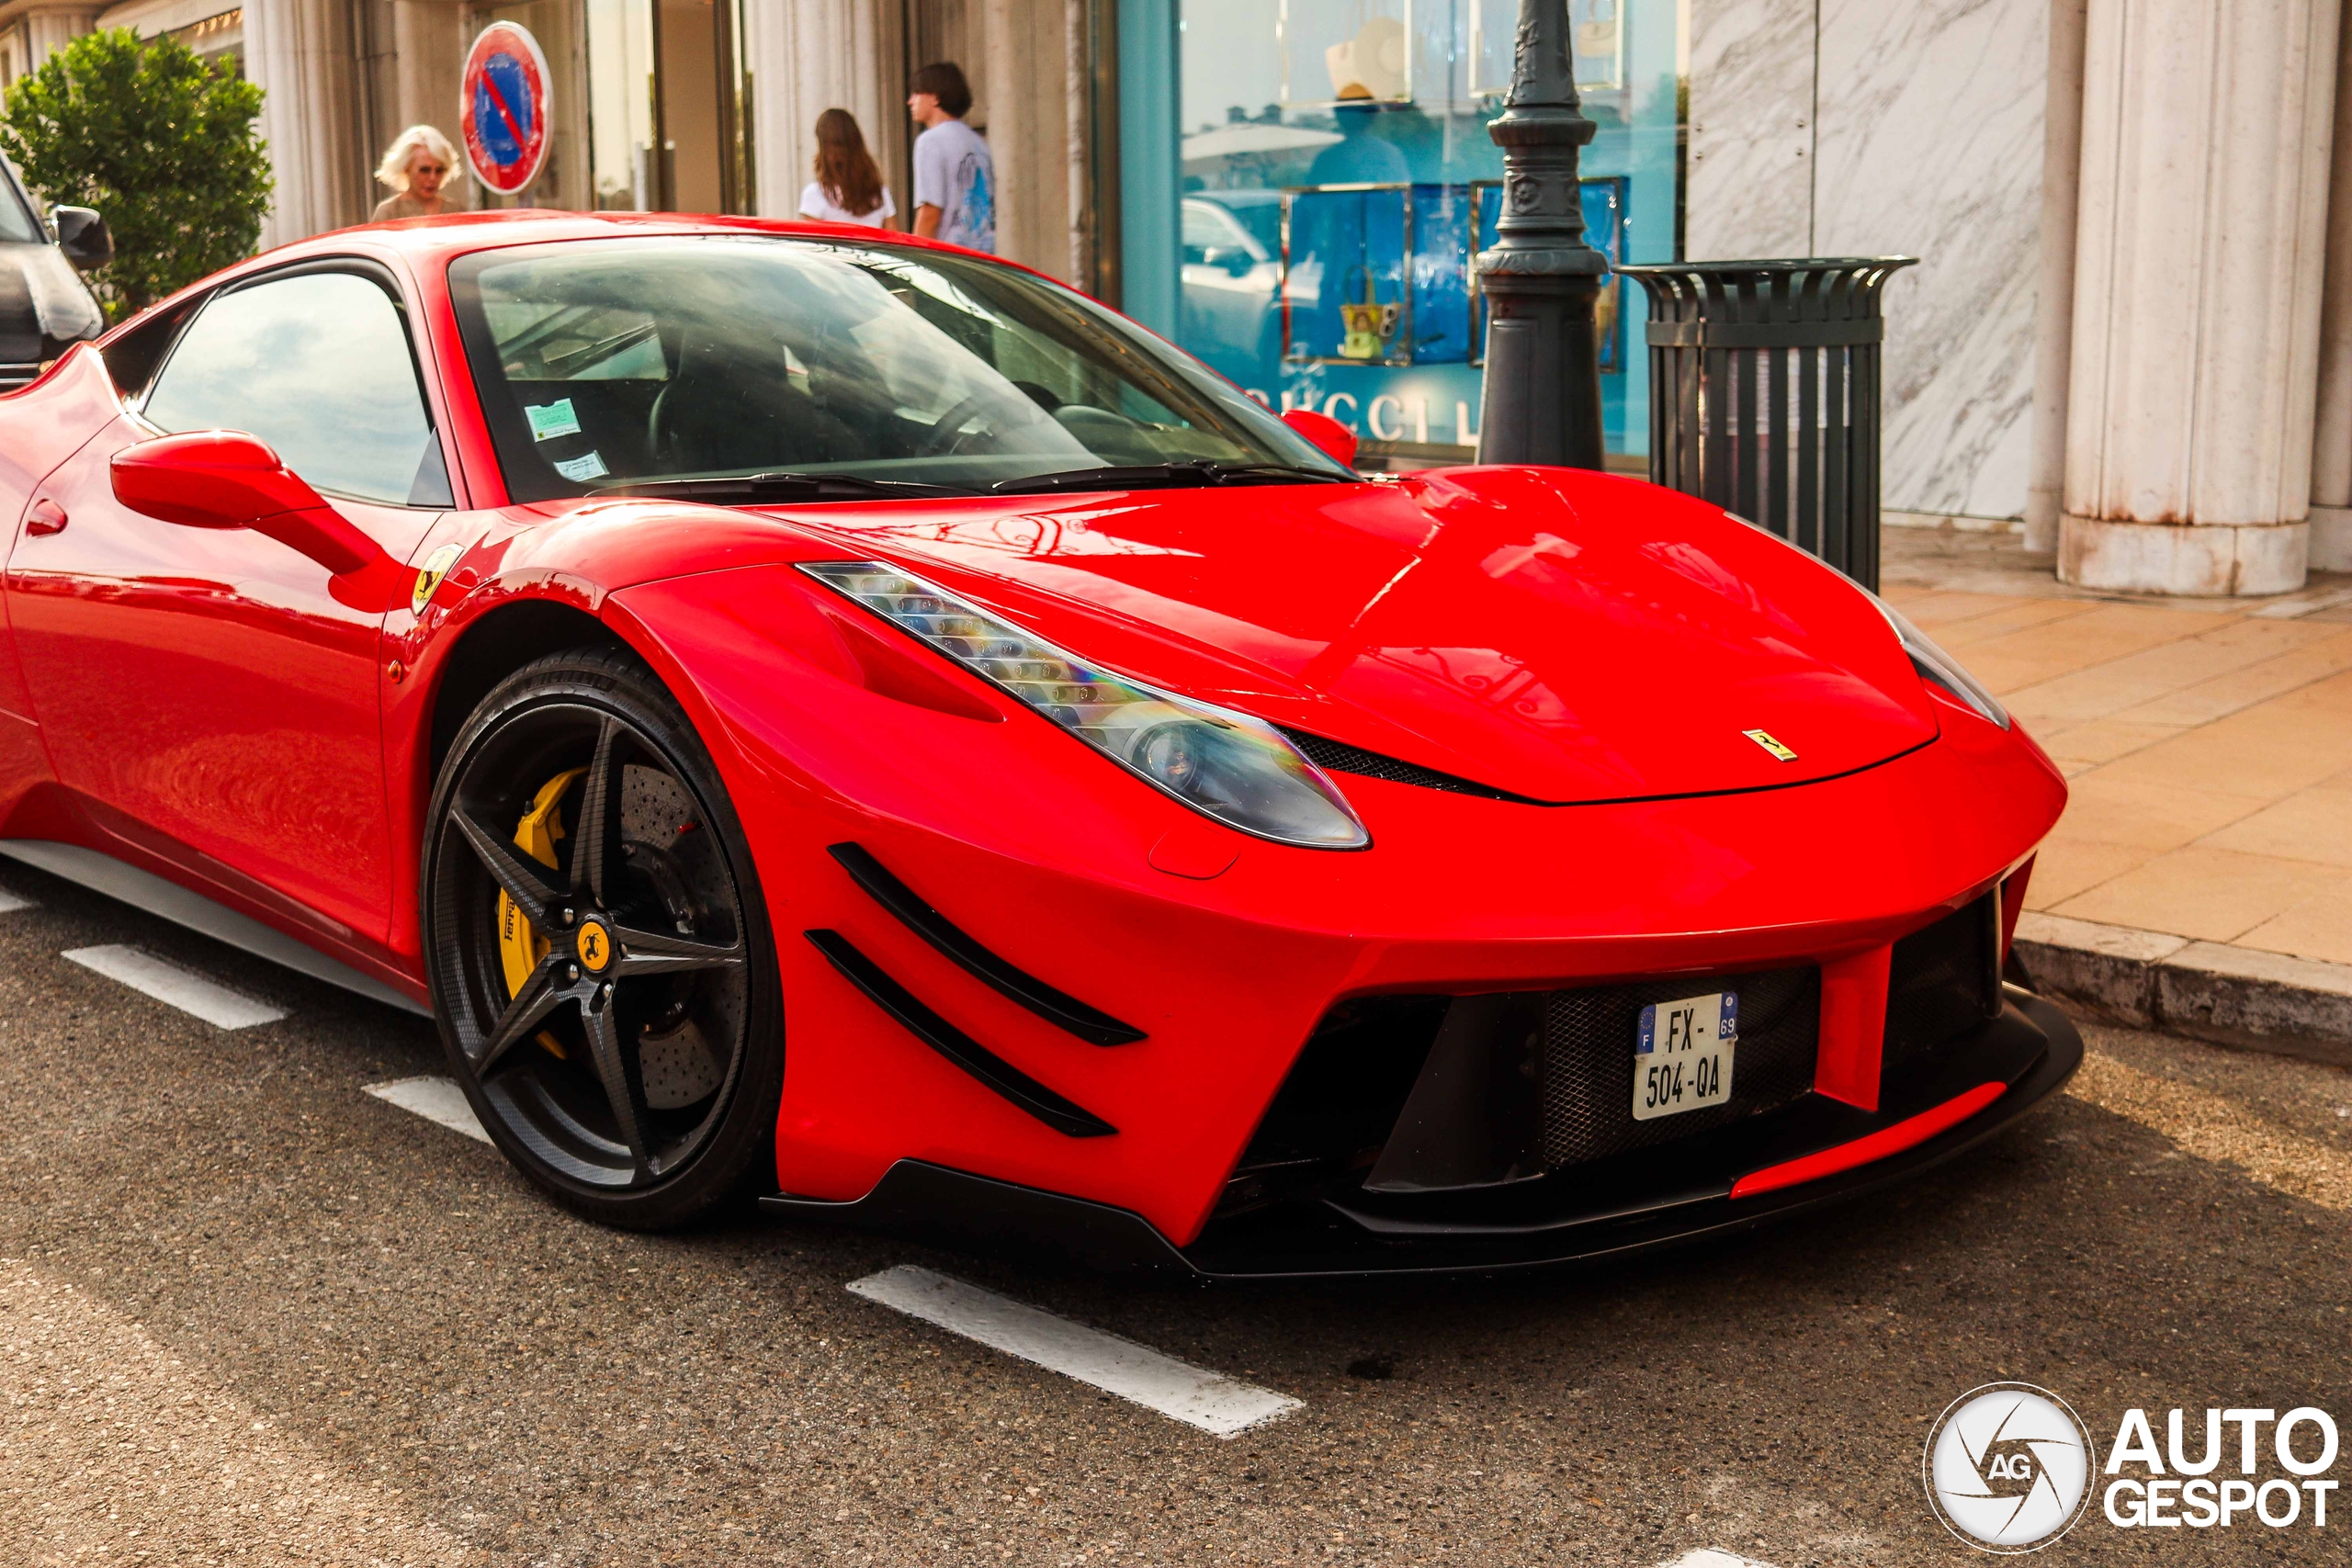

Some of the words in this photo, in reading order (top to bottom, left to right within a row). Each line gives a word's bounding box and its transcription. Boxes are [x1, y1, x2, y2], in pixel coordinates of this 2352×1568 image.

[1720, 1018, 1735, 1035] 69
[1643, 1034, 1650, 1047] F
[1645, 1055, 1719, 1109] 504-QA
